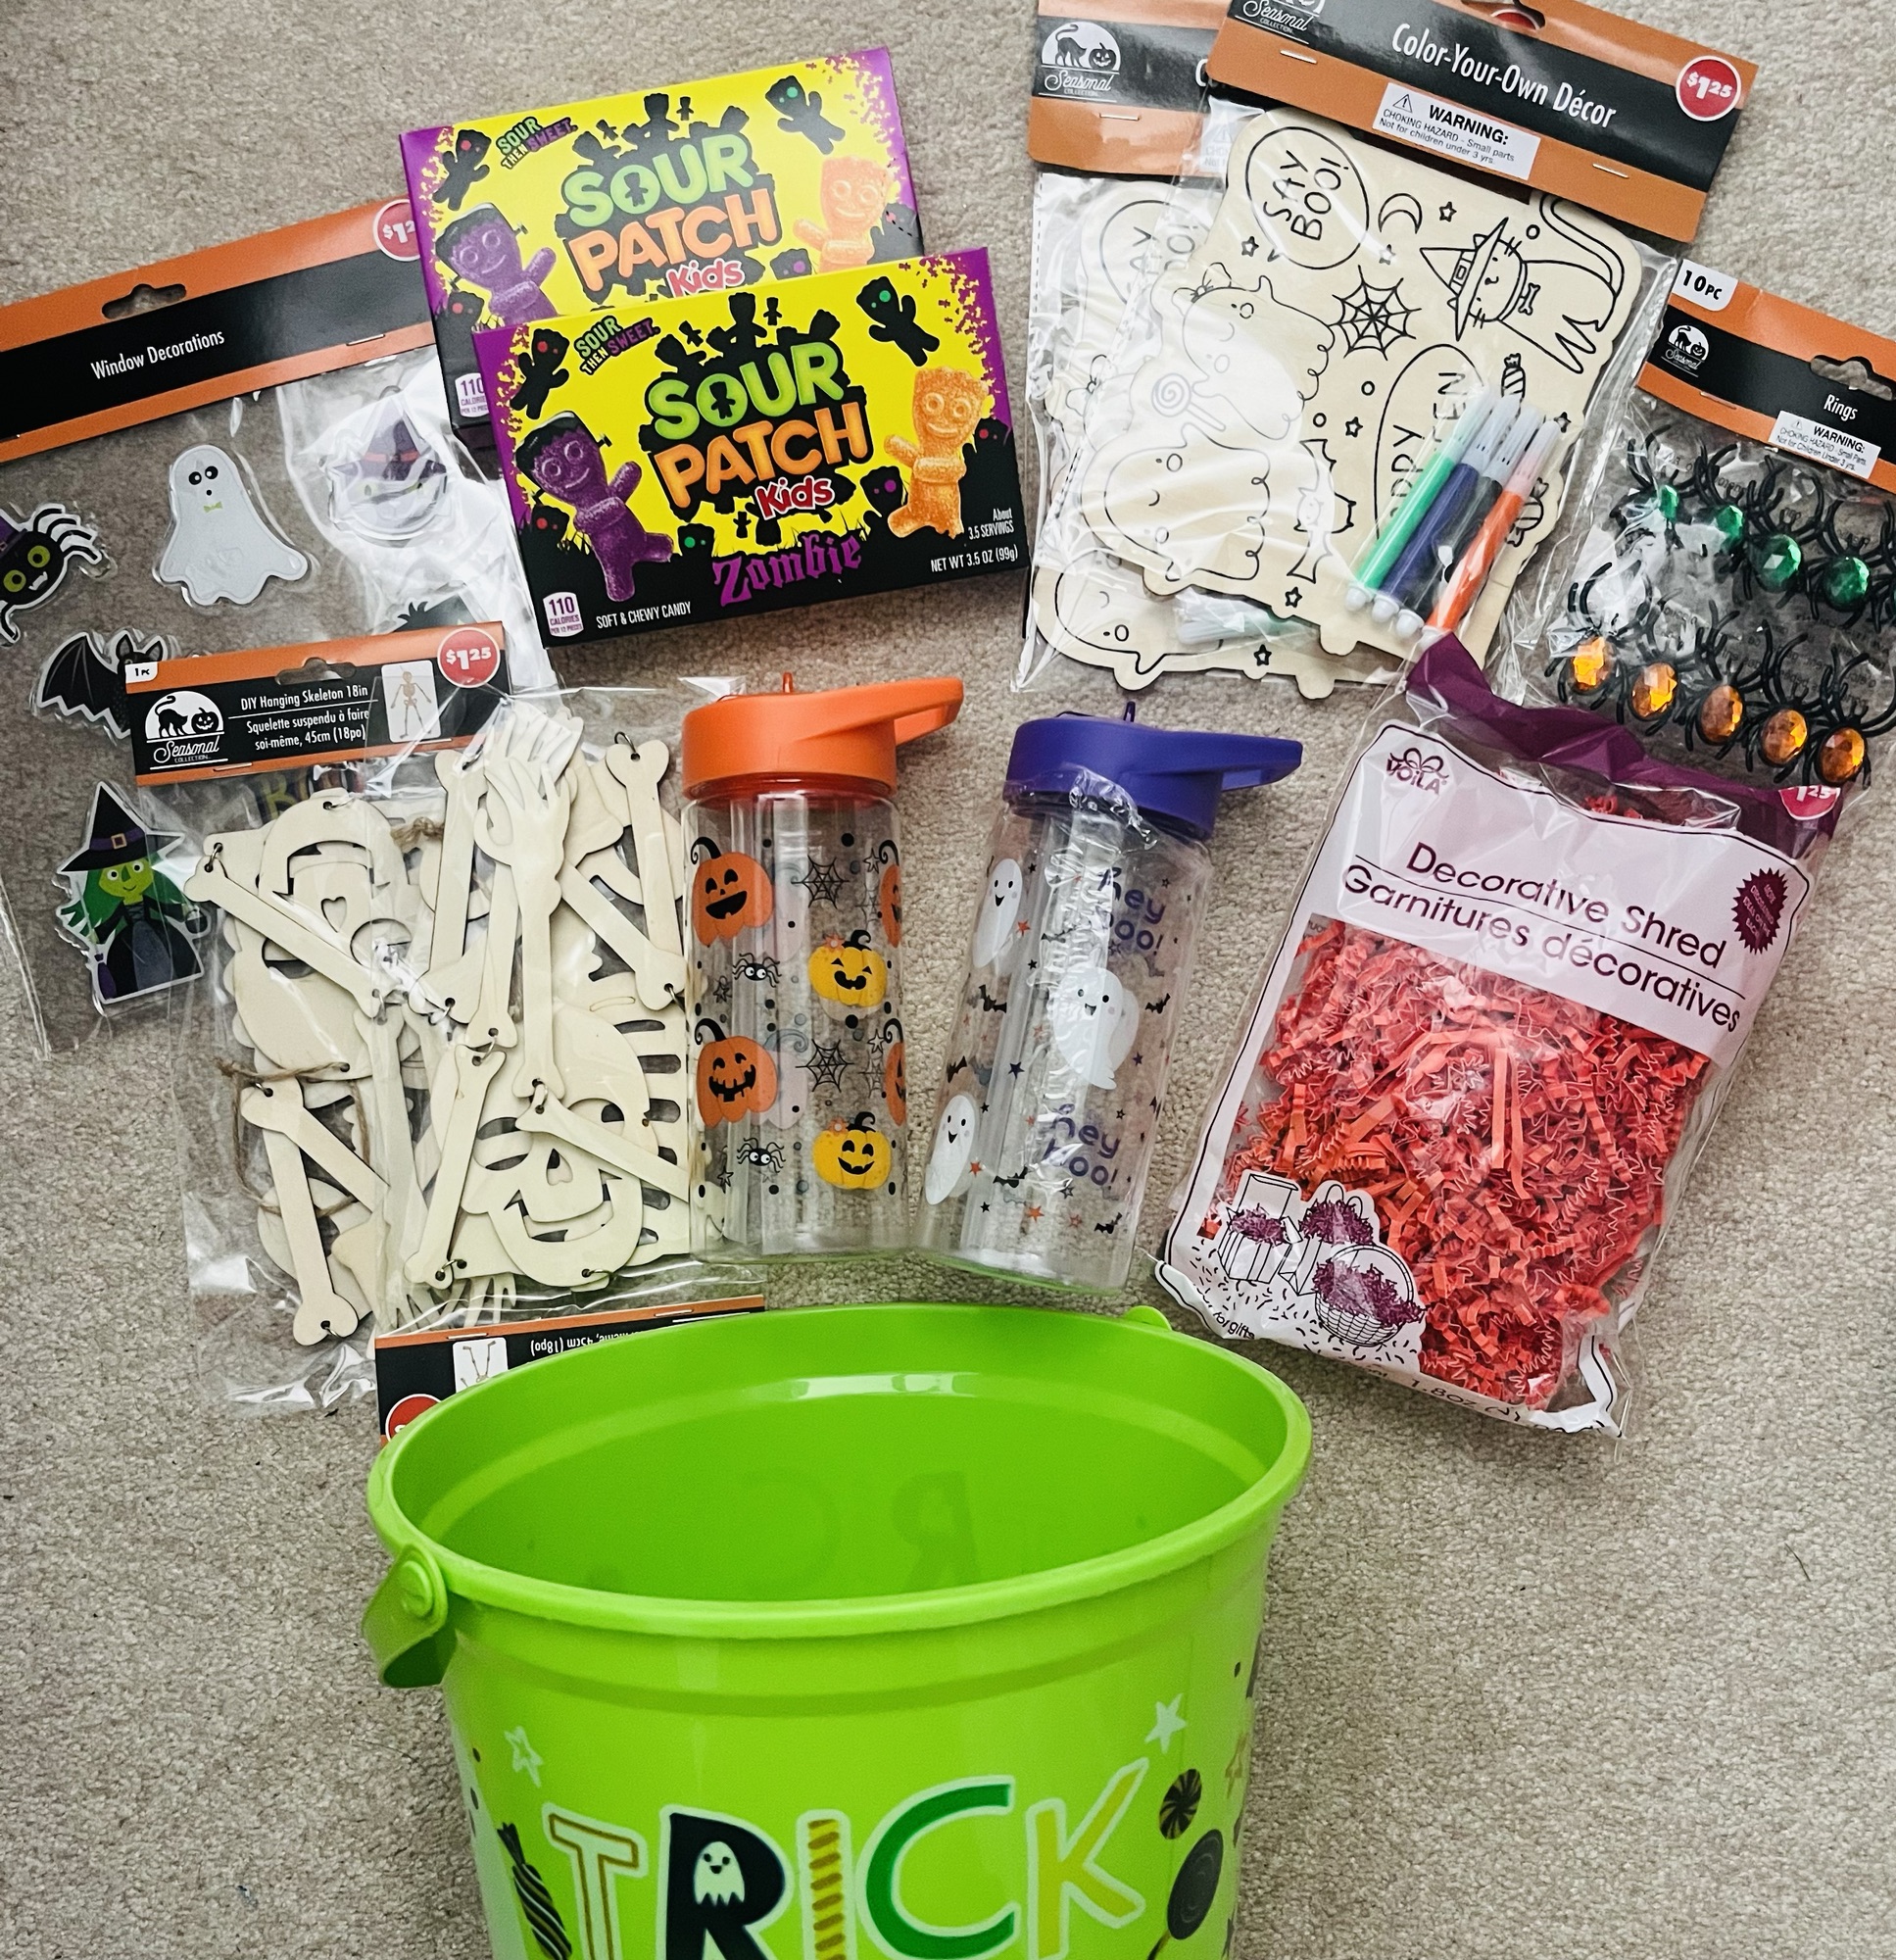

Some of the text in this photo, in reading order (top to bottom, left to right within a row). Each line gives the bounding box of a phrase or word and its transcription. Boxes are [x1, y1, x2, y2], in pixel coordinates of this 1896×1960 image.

[1242, 0, 1314, 32] Seasonal
[1044, 70, 1116, 92] Seasonal
[1391, 23, 1617, 128] Color-Your-Own Décor
[499, 118, 541, 155] SOUR
[1379, 118, 1395, 129] Not
[1395, 122, 1408, 134] for
[1409, 128, 1444, 146] children
[1445, 141, 1471, 157] under
[1473, 150, 1479, 159] 3
[1383, 108, 1423, 129] CHOKING
[1424, 122, 1459, 142] HAZARD
[1467, 138, 1492, 153] Small
[1492, 148, 1515, 162] parts
[1429, 104, 1509, 146] WARNING:
[502, 144, 529, 169] THEN
[563, 133, 754, 227] SOUR
[1262, 150, 1309, 222] SAY
[1290, 157, 1349, 241] BOO!
[568, 188, 778, 292] PATCH
[666, 258, 746, 297] Kids
[90, 329, 225, 380] Window Decorations
[575, 317, 621, 358] SOUR
[581, 347, 609, 374] THEN
[648, 342, 845, 440] SOUR
[1823, 394, 1859, 421] Rings
[654, 401, 868, 509] PATCH
[1776, 434, 1787, 443] Not
[1787, 438, 1797, 447] for
[1779, 426, 1809, 443] CHOKING
[1810, 439, 1835, 452] HAZARD
[1813, 425, 1866, 454] WARNING:
[754, 474, 835, 521] Kids
[993, 508, 1013, 521] About
[967, 519, 1015, 540] 3.5 SERVINGS
[712, 533, 862, 607] Zombie
[930, 543, 1019, 573] NET WT 3.5 OZ (99g)
[548, 596, 576, 616] 110
[550, 613, 580, 626] CALORIES
[596, 601, 692, 629] SOFT & CHEWY CANDY
[240, 685, 368, 710] DIY Hanging Skeleton 18in
[246, 708, 369, 735] Squelette suspendu à faire
[255, 724, 366, 751] soi-même, 45cm (18po)
[153, 735, 220, 763] Seasonal
[1405, 841, 1727, 969] Decorative Shred
[1342, 864, 1741, 1033] Garnitures décoratives
[530, 1337, 564, 1357] (18po)
[543, 1758, 1150, 1960] TRICK
